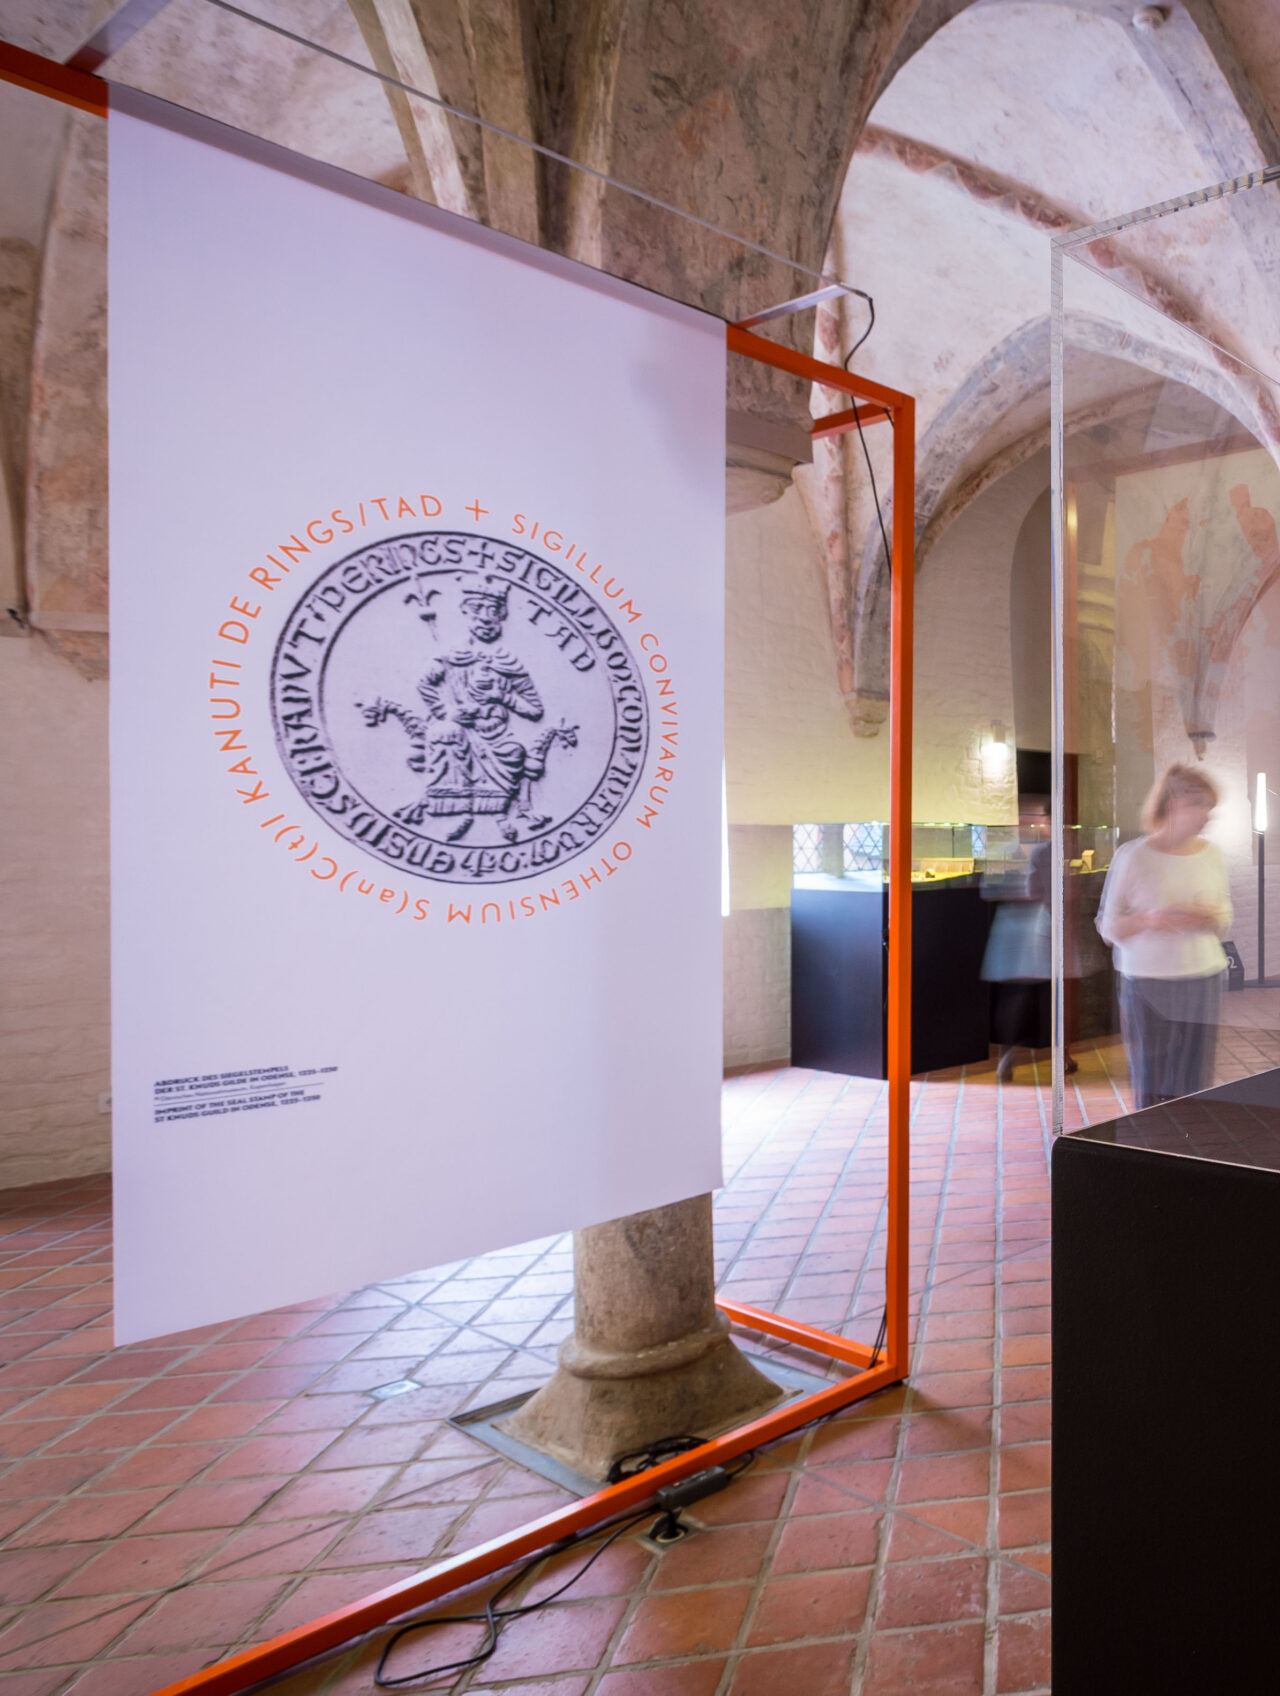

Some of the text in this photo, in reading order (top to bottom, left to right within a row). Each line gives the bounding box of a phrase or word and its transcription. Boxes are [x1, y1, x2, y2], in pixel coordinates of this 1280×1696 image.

[511, 513, 643, 624] SIGILLUM
[217, 595, 263, 646] DE
[210, 659, 270, 804] KANUTI
[636, 632, 679, 829] CONVIVARUM
[447, 841, 633, 924] OTHENSIUM
[153, 1076, 199, 1087] ABDRUCK
[154, 1086, 173, 1095] DER
